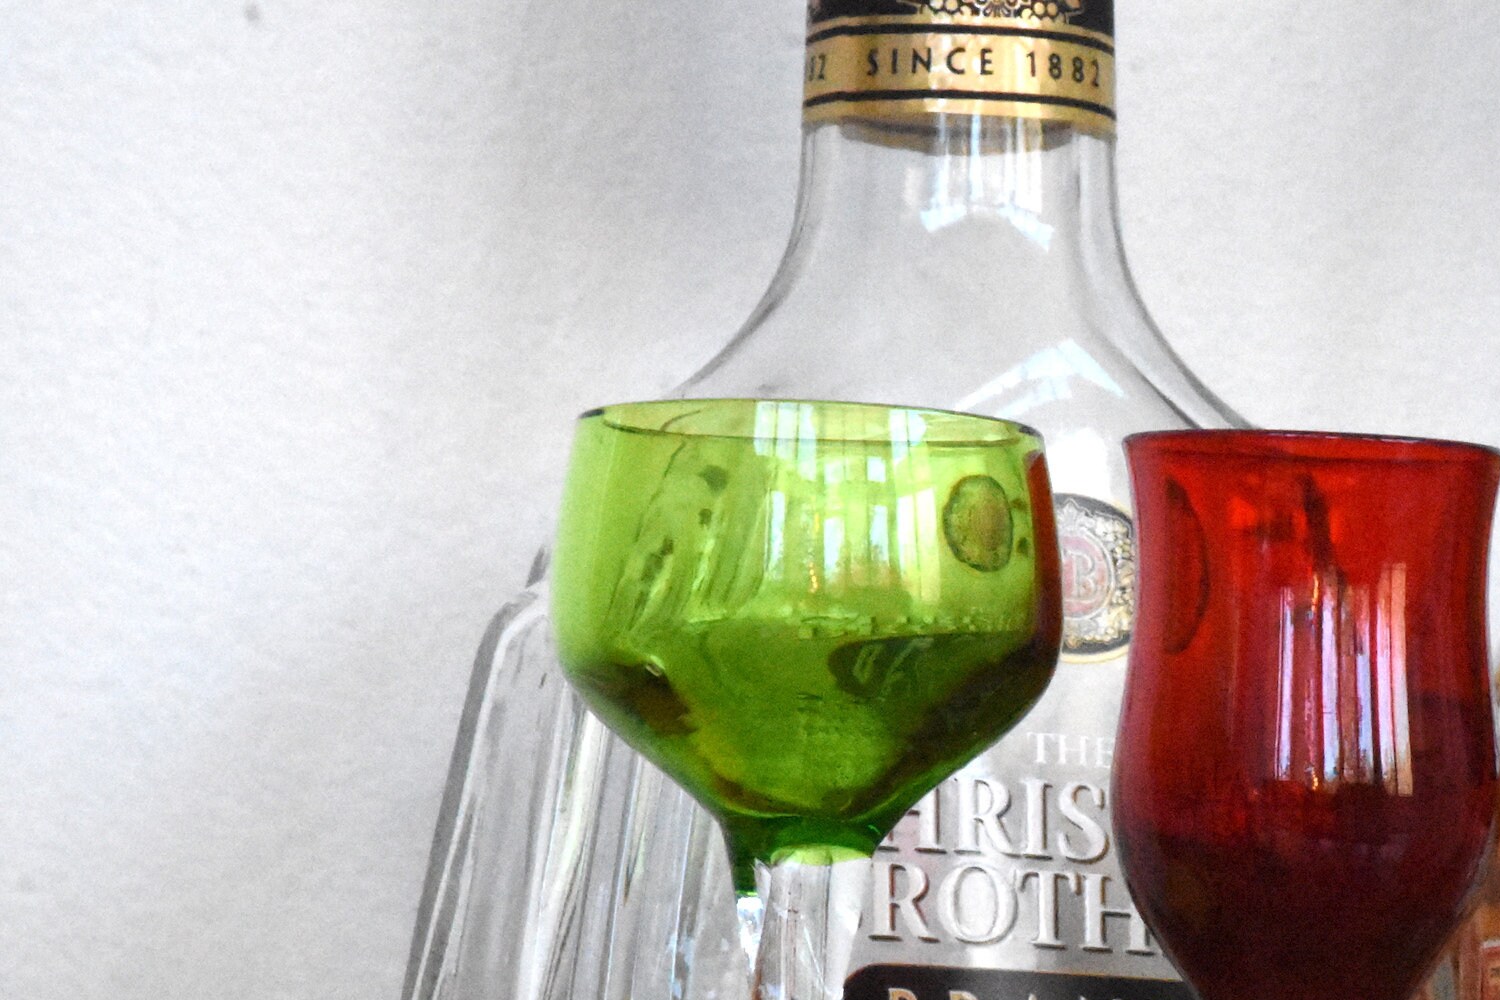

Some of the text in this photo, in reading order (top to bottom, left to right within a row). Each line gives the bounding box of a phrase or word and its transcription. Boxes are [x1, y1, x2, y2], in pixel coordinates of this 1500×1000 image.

[866, 47, 1100, 87] SINCE 1882
[868, 858, 1156, 957] ROTH
